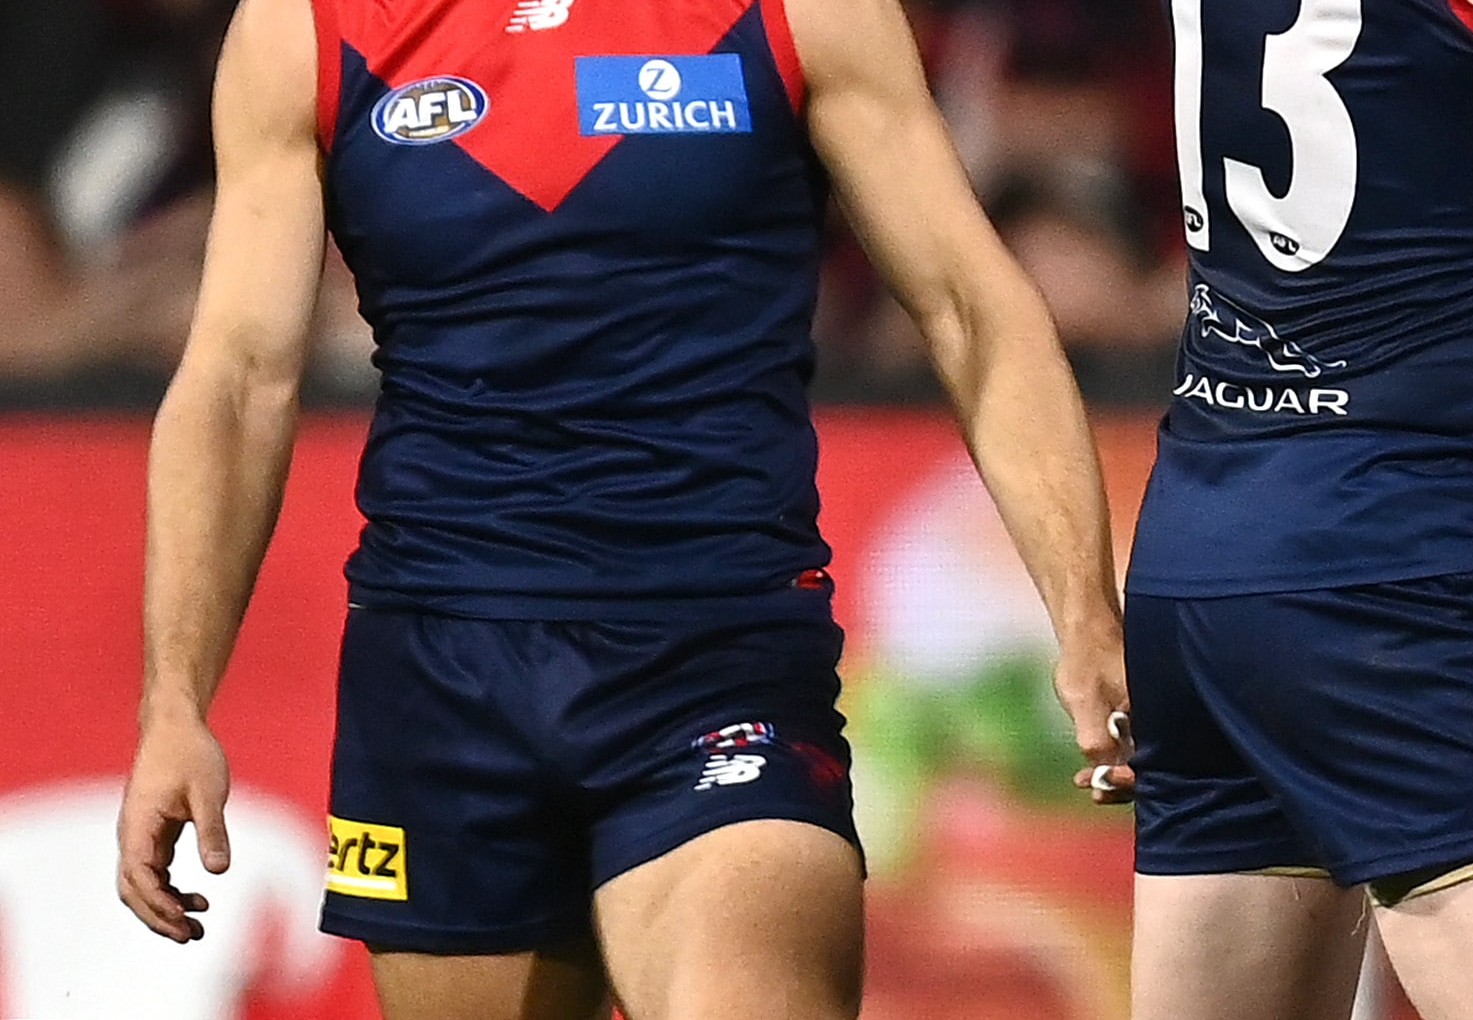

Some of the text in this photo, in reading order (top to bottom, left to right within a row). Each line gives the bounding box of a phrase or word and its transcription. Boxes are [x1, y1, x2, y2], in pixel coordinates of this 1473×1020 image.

[383, 89, 478, 133] AFL
[593, 100, 735, 132] ZURICH
[1174, 374, 1350, 415] JAGUAR
